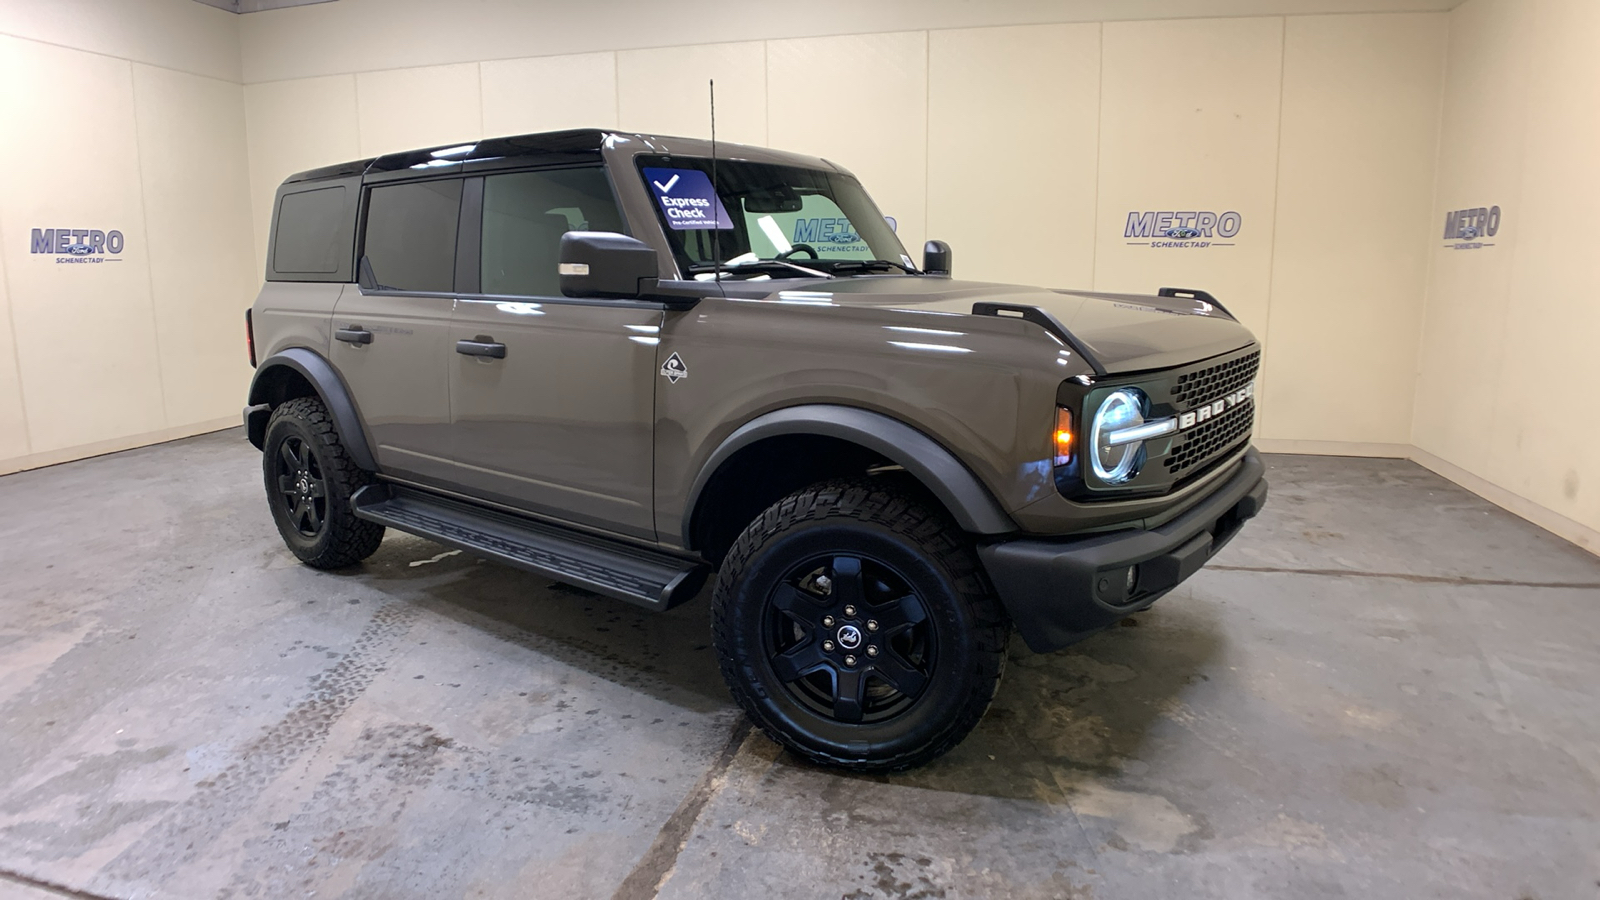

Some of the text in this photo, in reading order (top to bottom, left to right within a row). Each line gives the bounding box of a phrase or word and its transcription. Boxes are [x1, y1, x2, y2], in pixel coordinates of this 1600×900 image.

[660, 196, 710, 208] Express
[667, 208, 706, 218] Check
[1124, 211, 1242, 238] METRO
[1443, 205, 1501, 239] METRO
[30, 228, 124, 254] METRO
[1179, 381, 1255, 430] BRONCO
